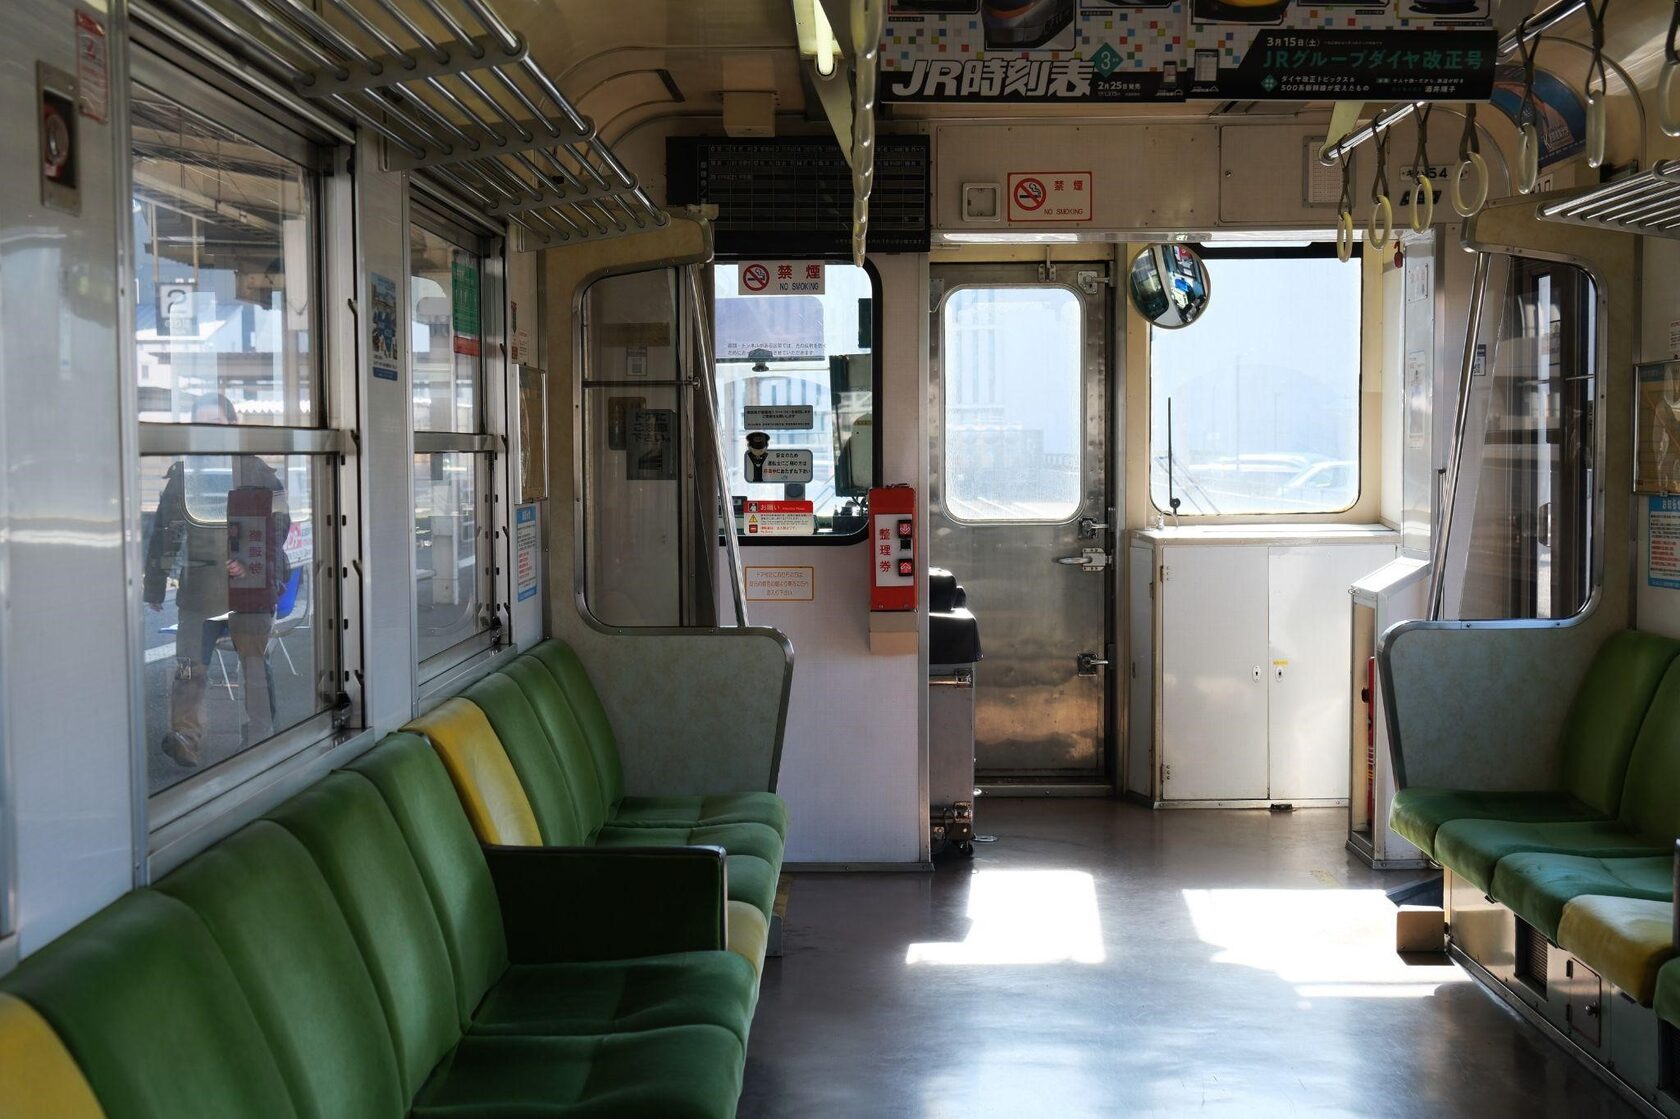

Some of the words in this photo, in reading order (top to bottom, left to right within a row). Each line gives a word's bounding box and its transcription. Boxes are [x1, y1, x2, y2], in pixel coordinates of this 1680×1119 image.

[1263, 49, 1484, 70] JRグループダイヤ改正号
[892, 57, 1097, 97] JR時刻表
[1053, 180, 1084, 191] 禁煙
[777, 264, 821, 280] 禁煙
[779, 282, 789, 291] NO
[791, 282, 819, 291] SMOKING
[879, 527, 892, 573] 整理券
